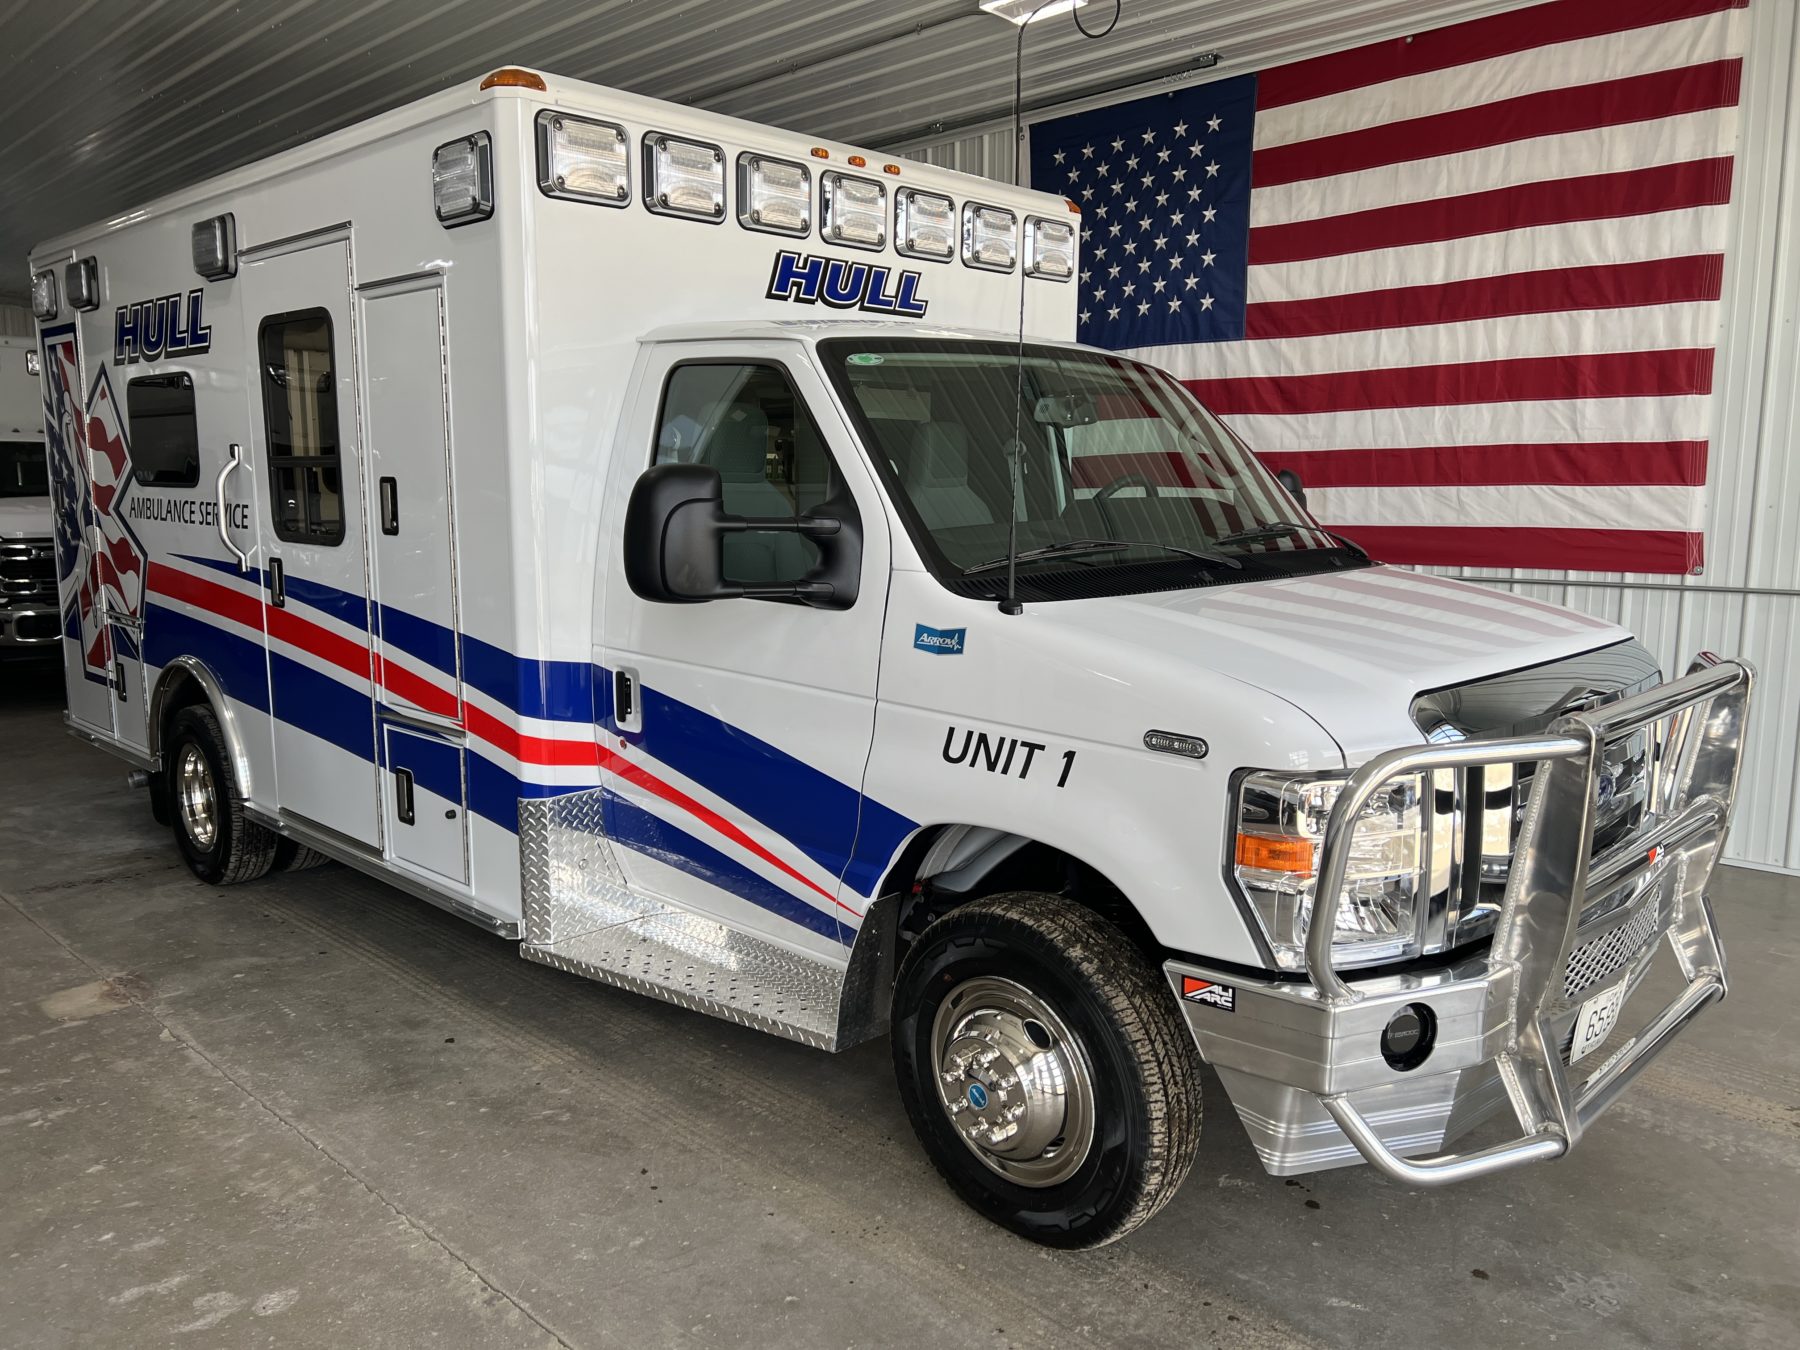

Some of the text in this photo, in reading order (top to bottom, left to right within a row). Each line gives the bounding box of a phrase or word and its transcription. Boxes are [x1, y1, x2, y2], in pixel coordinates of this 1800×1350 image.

[764, 250, 929, 318] HULL
[114, 288, 212, 366] HULL
[129, 497, 196, 524] AMBULANCE
[917, 632, 959, 648] ARROW
[942, 726, 1077, 788] UNIT 1
[1184, 984, 1233, 998] ALI
[1193, 992, 1233, 1008] ARC
